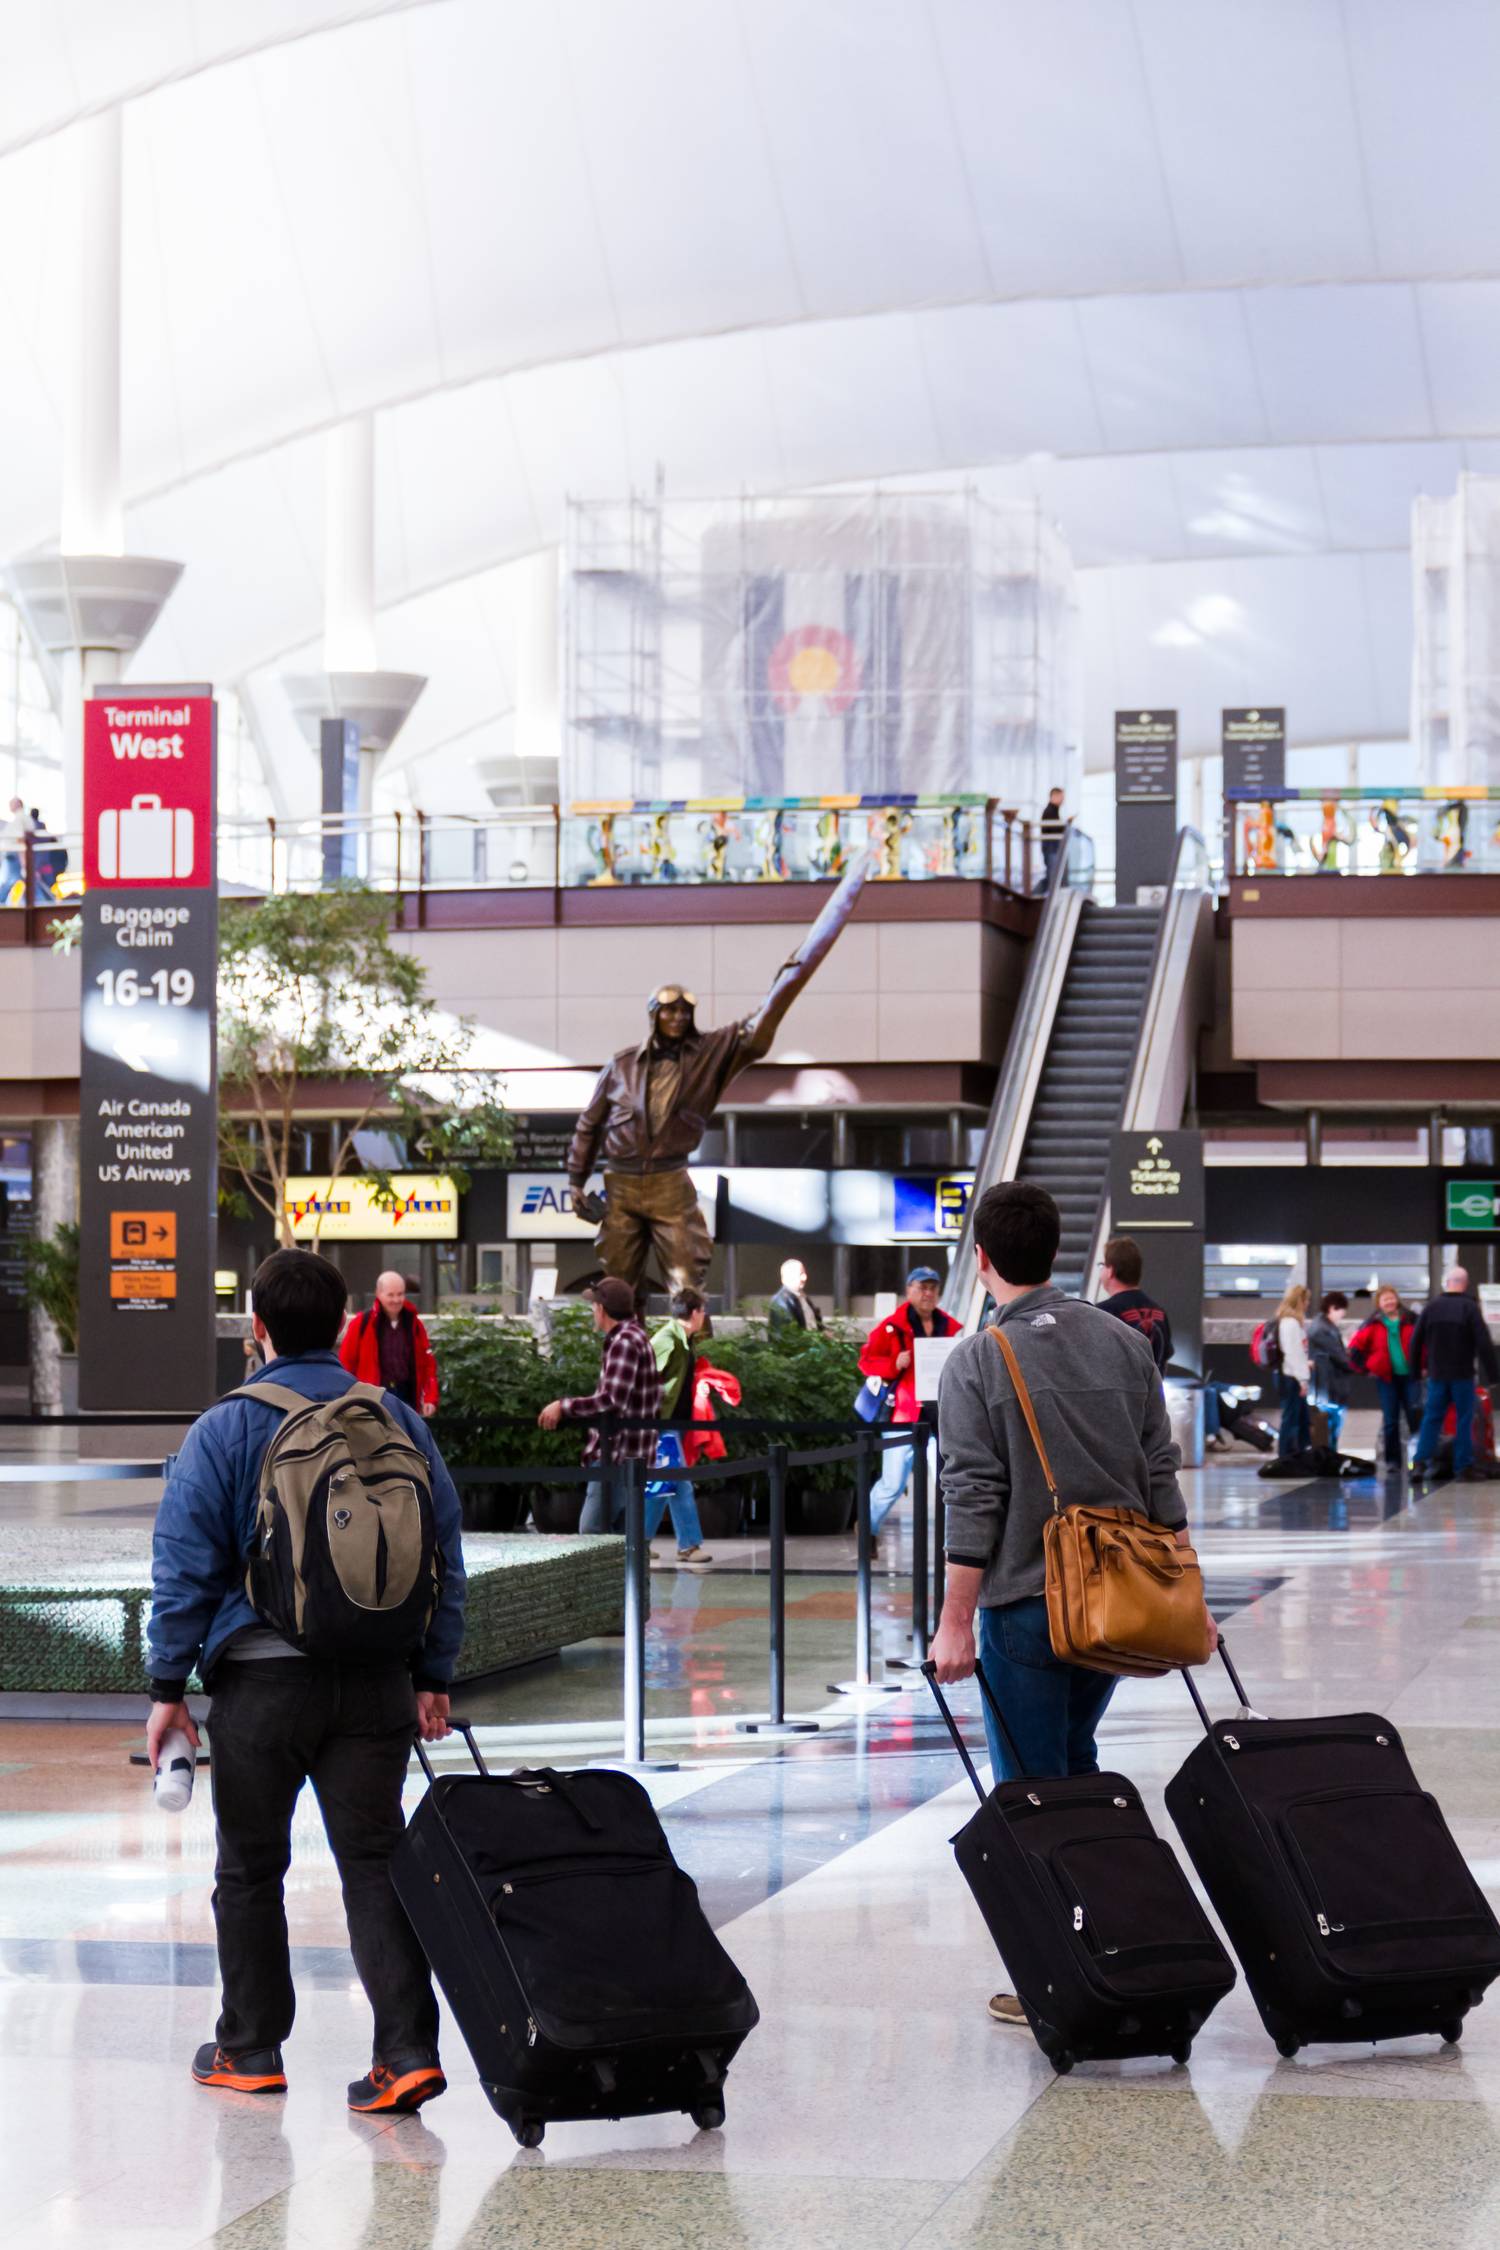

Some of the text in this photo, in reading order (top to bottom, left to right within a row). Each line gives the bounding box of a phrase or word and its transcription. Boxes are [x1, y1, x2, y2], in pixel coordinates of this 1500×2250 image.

[104, 705, 191, 727] Terminal
[110, 732, 184, 760] West
[100, 904, 190, 928] Baggage
[116, 926, 174, 947] Claim
[96, 968, 195, 1006] 16-19
[98, 1099, 191, 1117] Air Canada
[105, 1121, 184, 1139] American
[116, 1142, 174, 1160] United
[98, 1165, 191, 1186] US Airways
